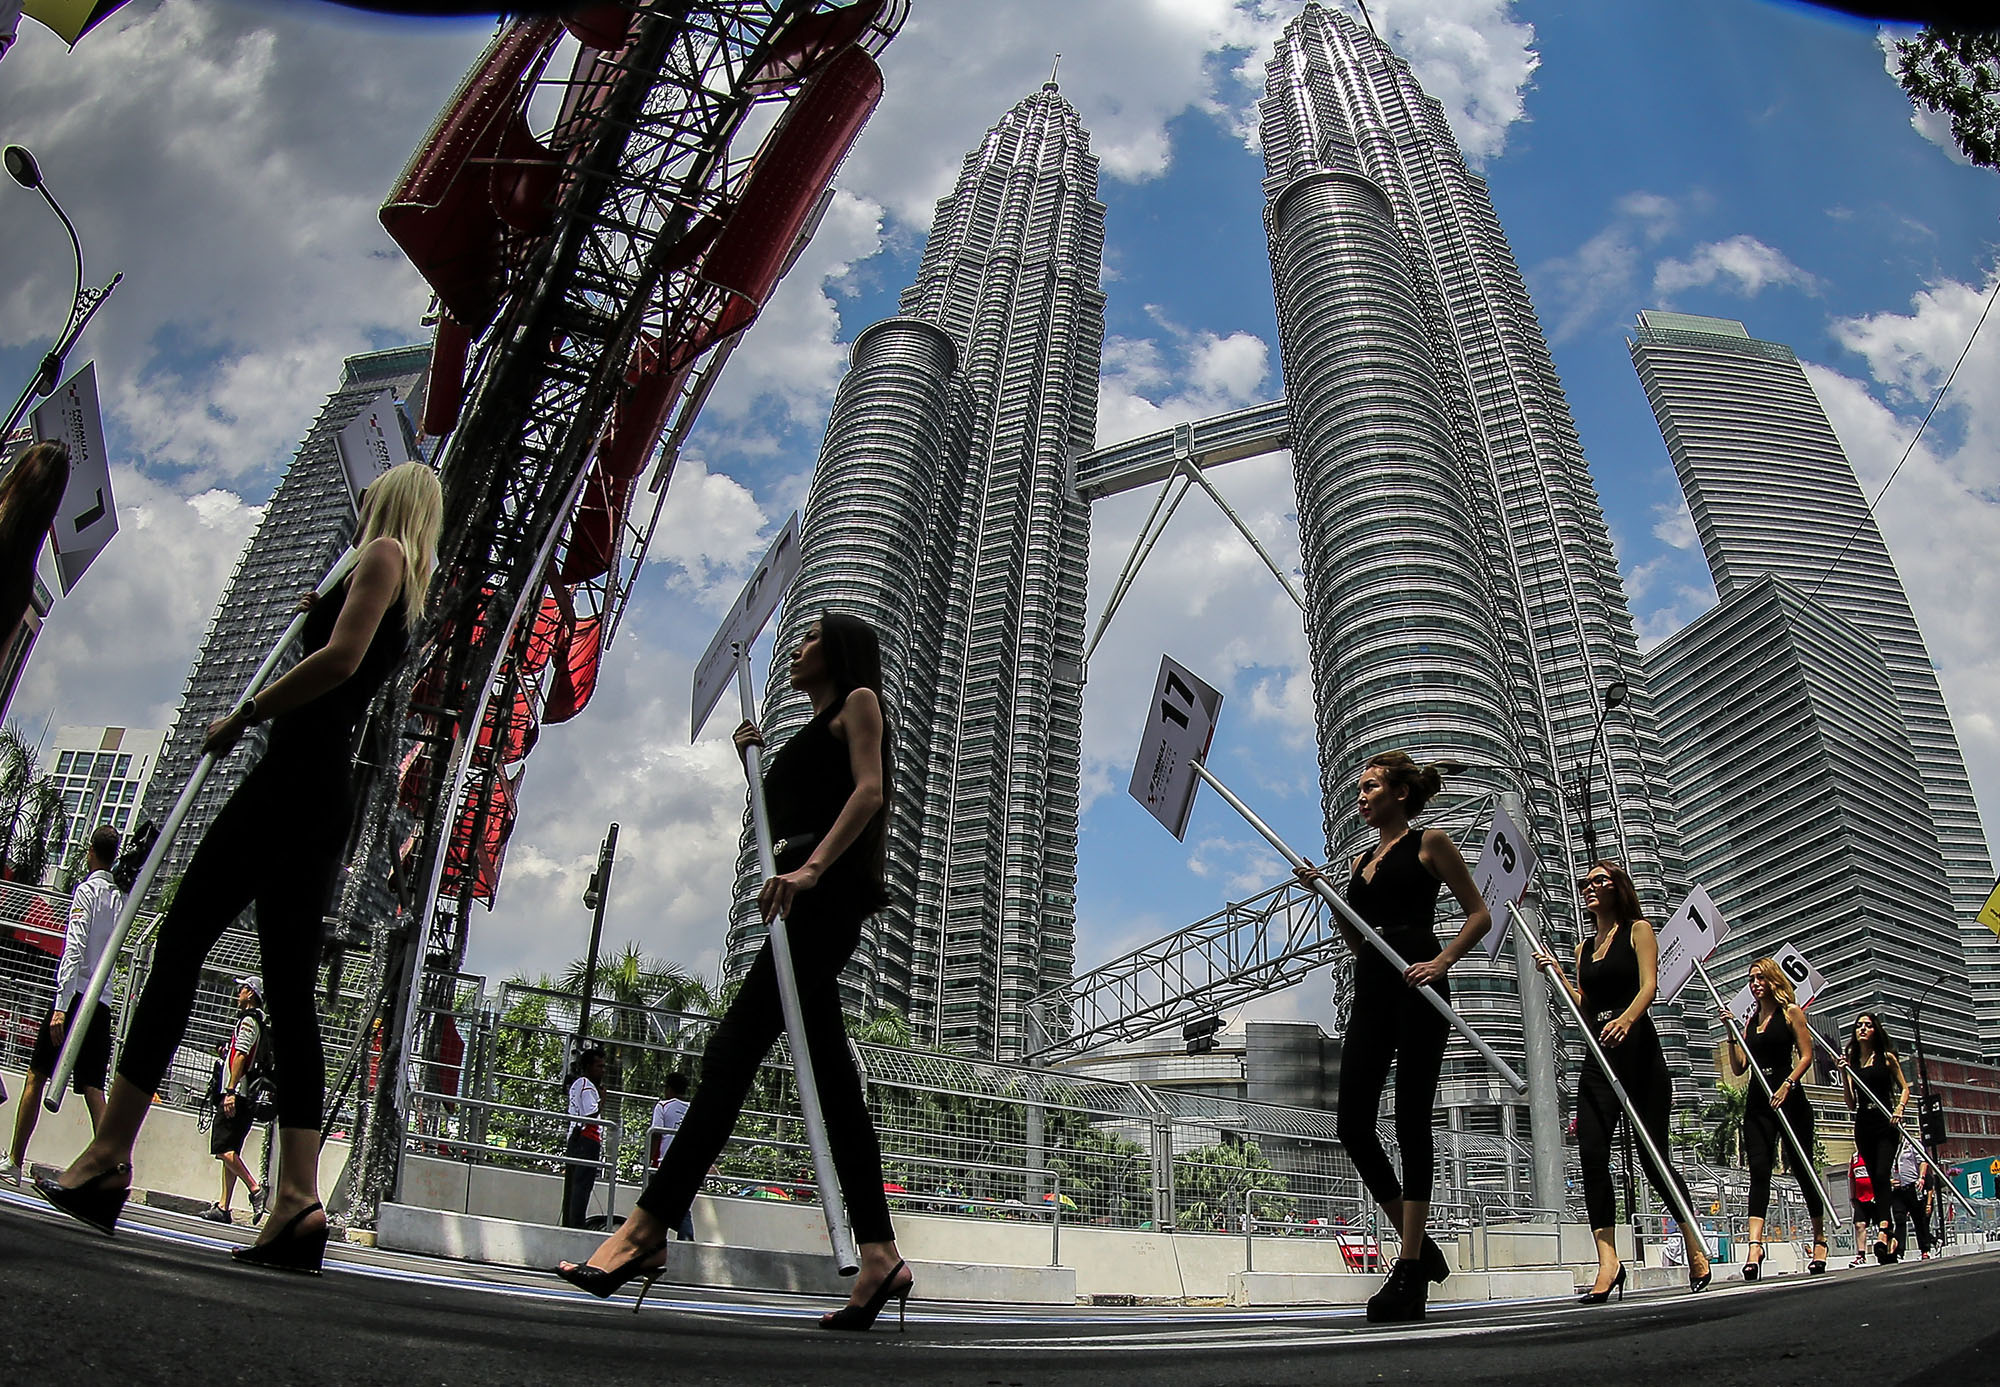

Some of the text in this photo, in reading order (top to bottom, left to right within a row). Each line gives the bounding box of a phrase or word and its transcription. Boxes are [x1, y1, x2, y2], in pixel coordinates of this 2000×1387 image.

[76, 408, 89, 461] FORMULA
[1161, 669, 1196, 731] 17
[1493, 831, 1517, 874] 3
[1686, 904, 1708, 933] 1
[1781, 955, 1809, 990] 6
